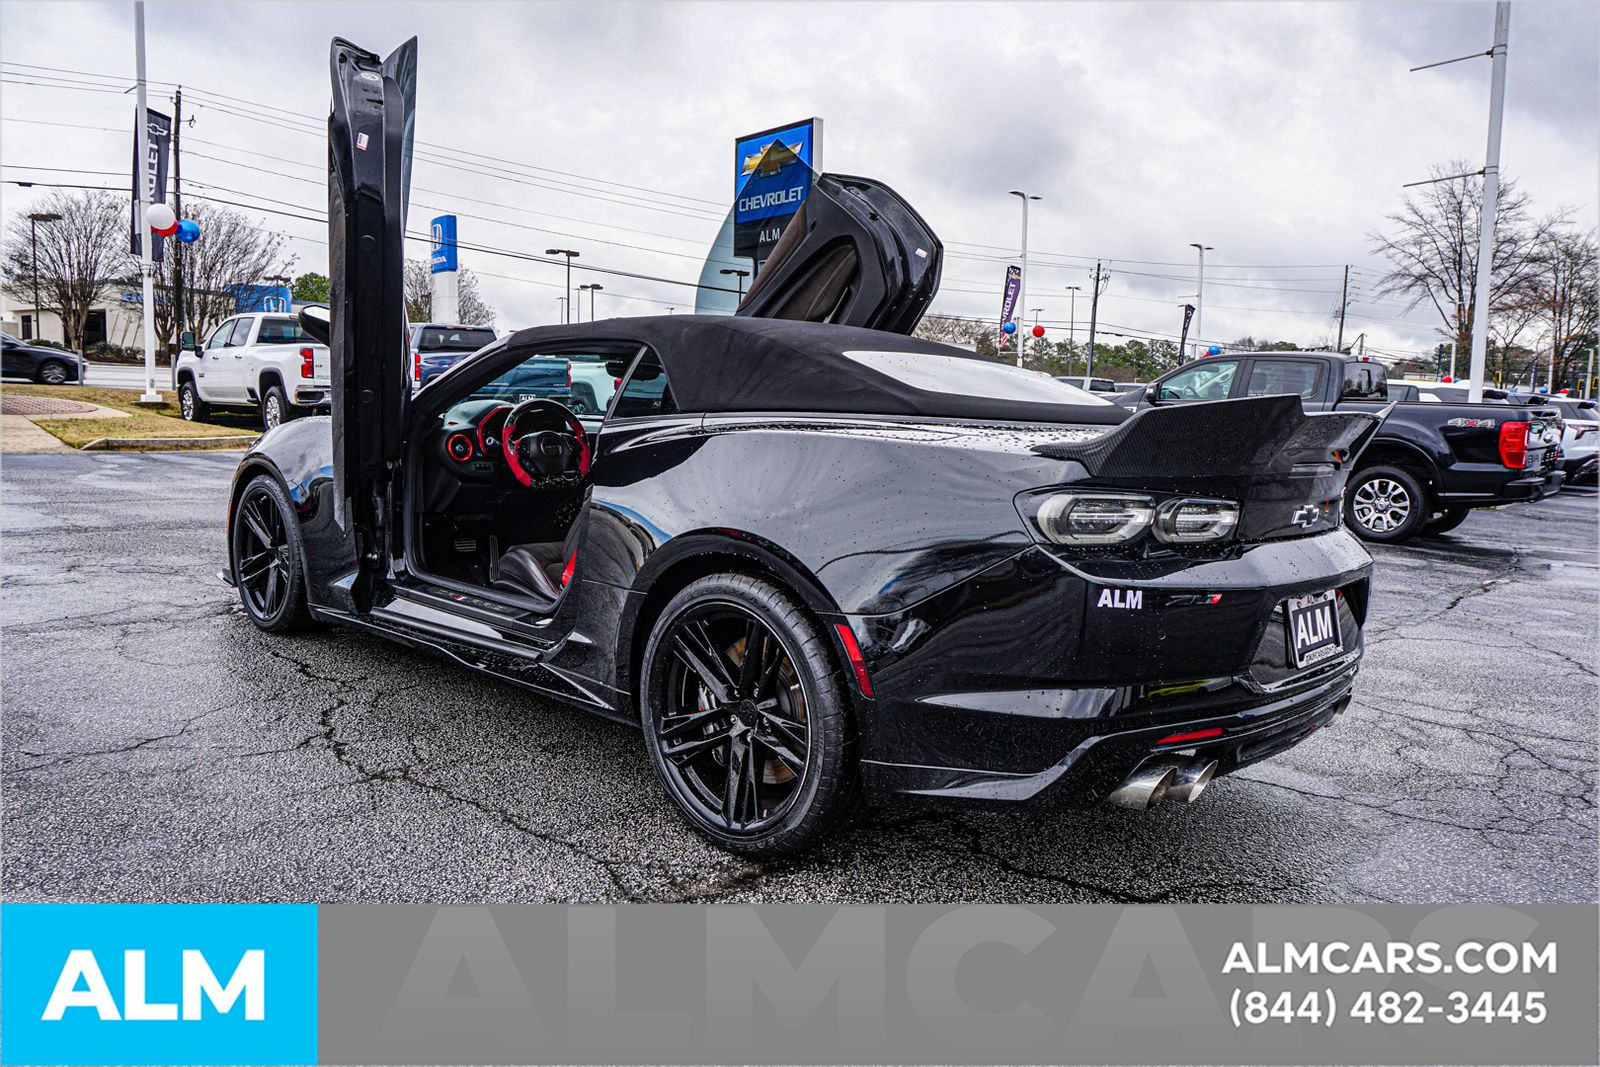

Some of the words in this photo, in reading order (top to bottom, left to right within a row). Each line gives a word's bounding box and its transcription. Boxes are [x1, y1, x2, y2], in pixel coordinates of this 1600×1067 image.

[739, 186, 804, 212] CHEVROLET
[759, 228, 780, 242] ALM
[1097, 588, 1143, 610] ALM
[1297, 605, 1334, 650] ALM
